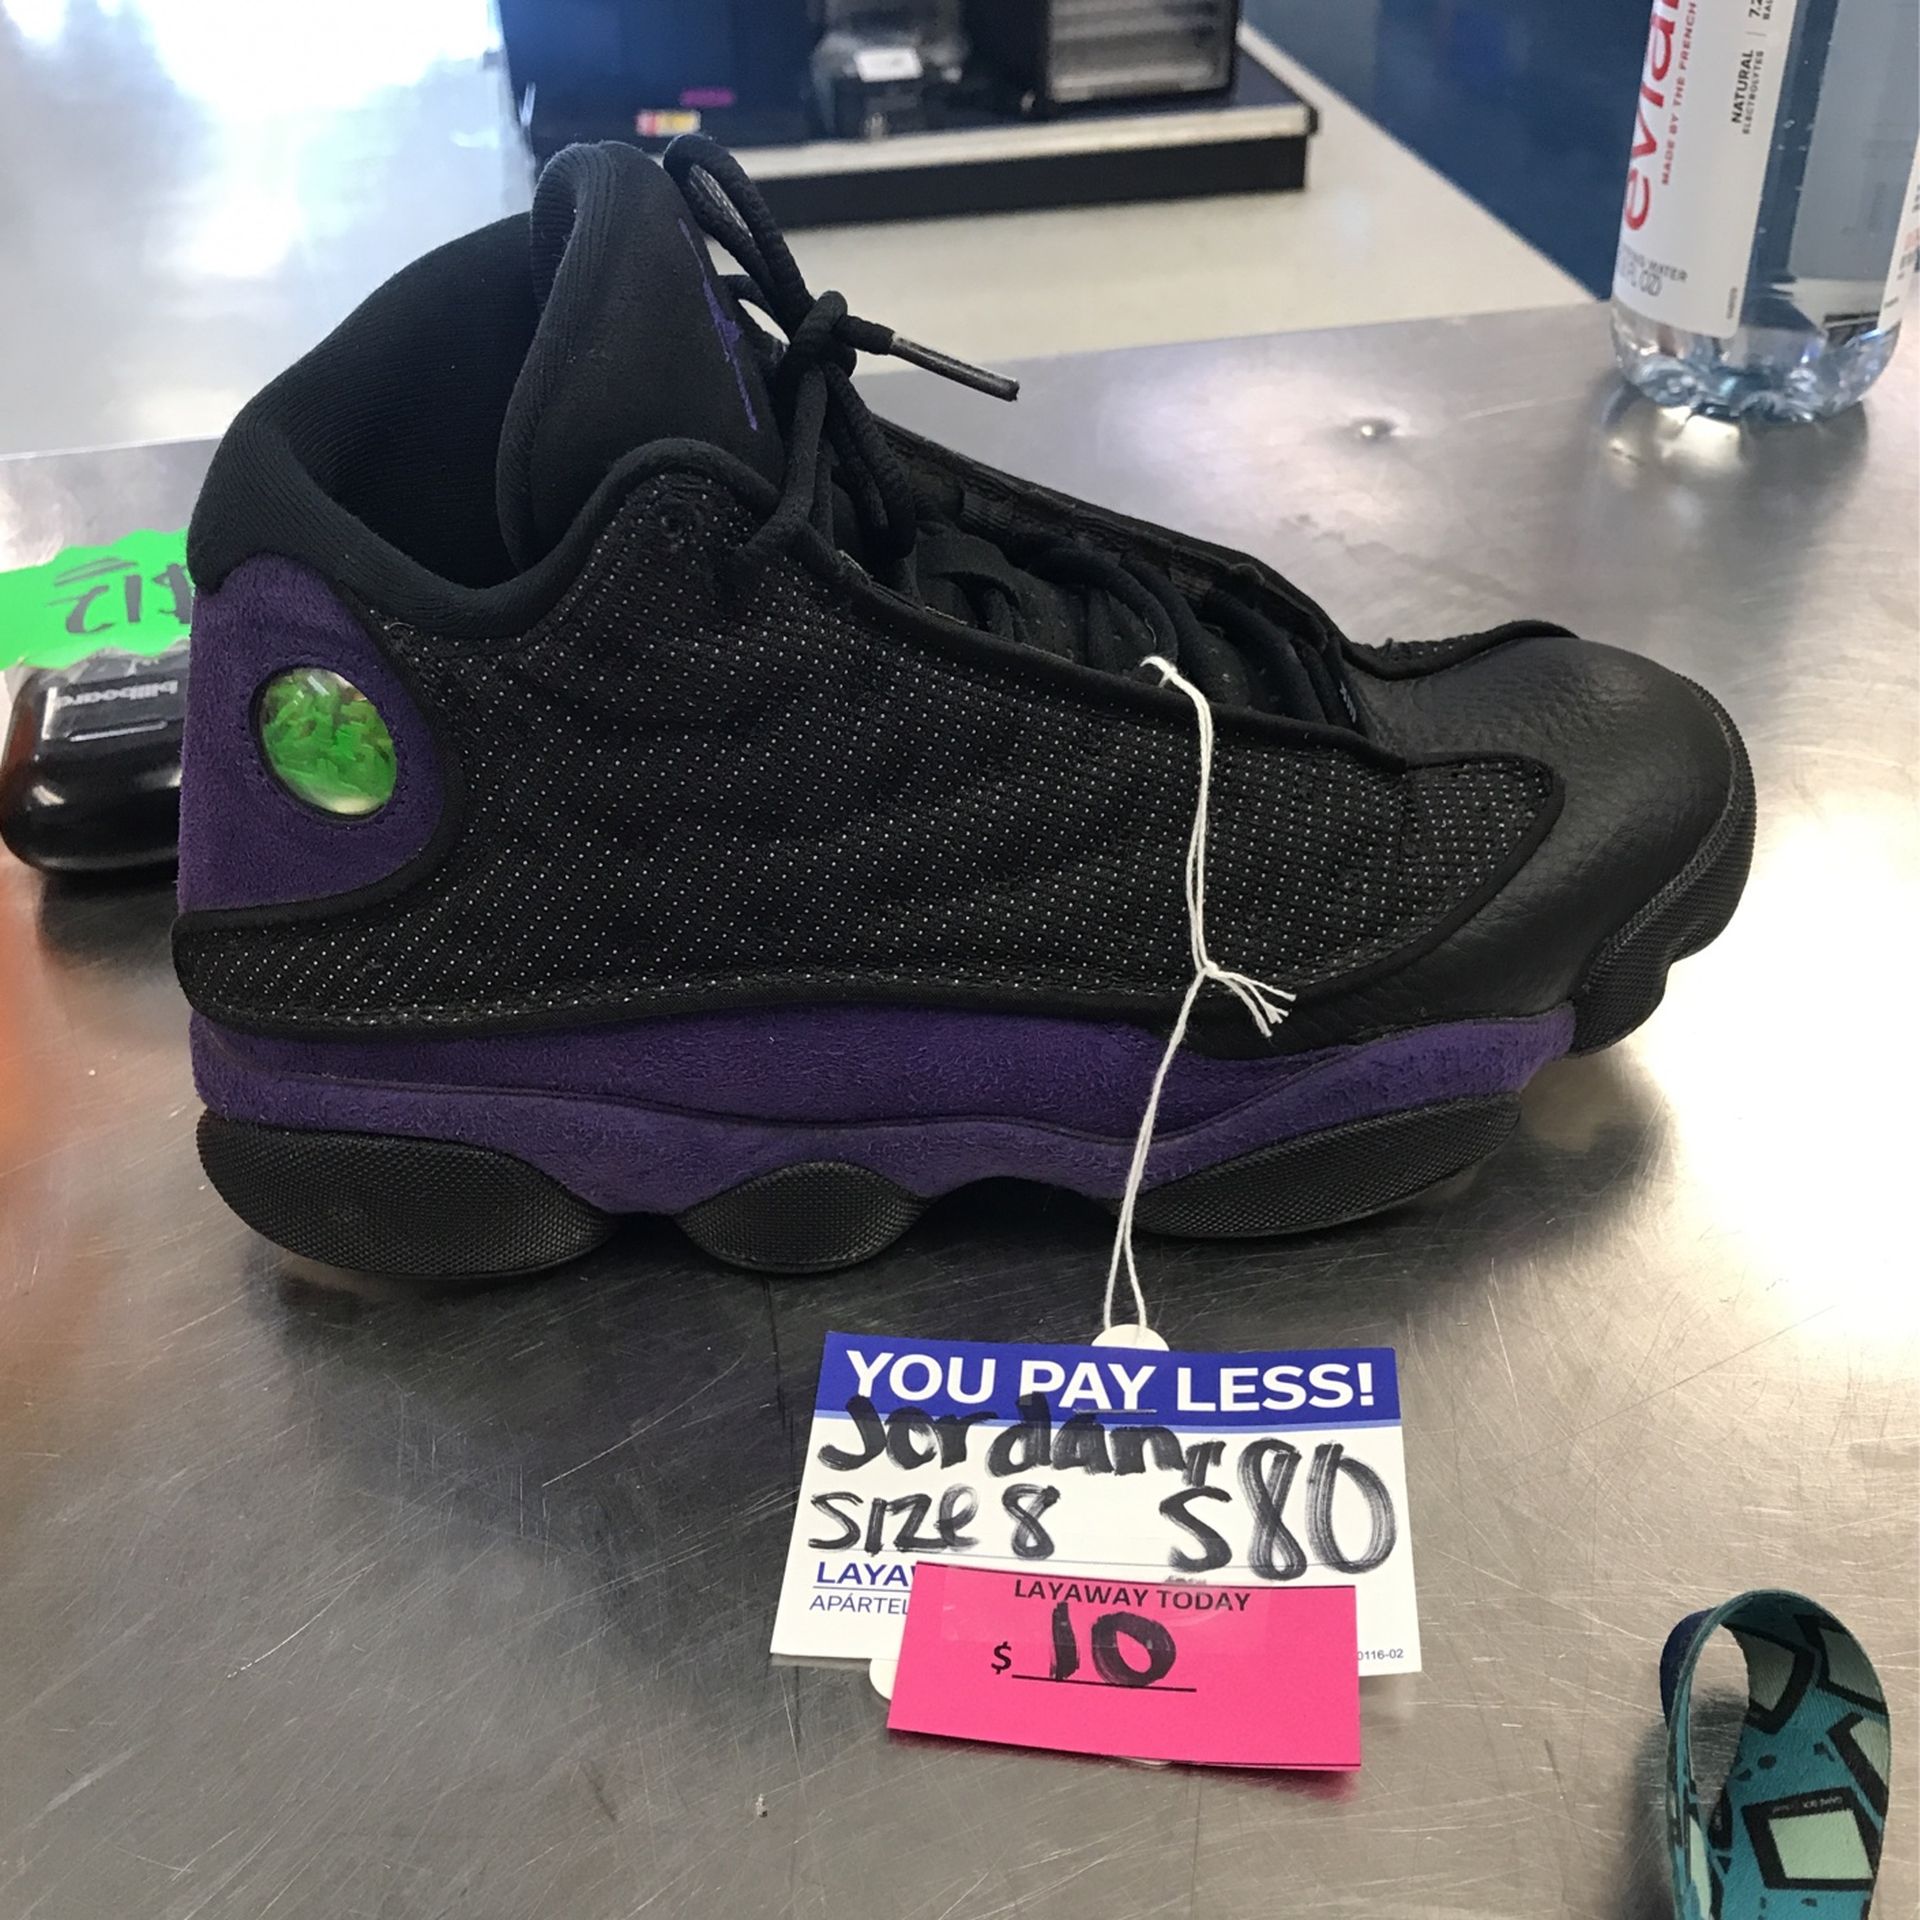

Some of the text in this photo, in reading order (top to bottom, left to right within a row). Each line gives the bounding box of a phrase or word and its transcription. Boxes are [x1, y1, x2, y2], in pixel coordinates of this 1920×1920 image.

[1623, 0, 1681, 231] evia
[1661, 1, 1698, 186] MADE BY THE FRENCH
[1730, 49, 1754, 124] NATURAL
[1741, 50, 1765, 135] ELECTROLYTES
[845, 1349, 1375, 1413] YOU PAY LESS!
[1000, 1482, 1062, 1561] 8
[816, 1561, 916, 1587] LAYA
[1014, 1579, 1251, 1612] LAYAWAY TODAY
[990, 1601, 1177, 1687] $ 10
